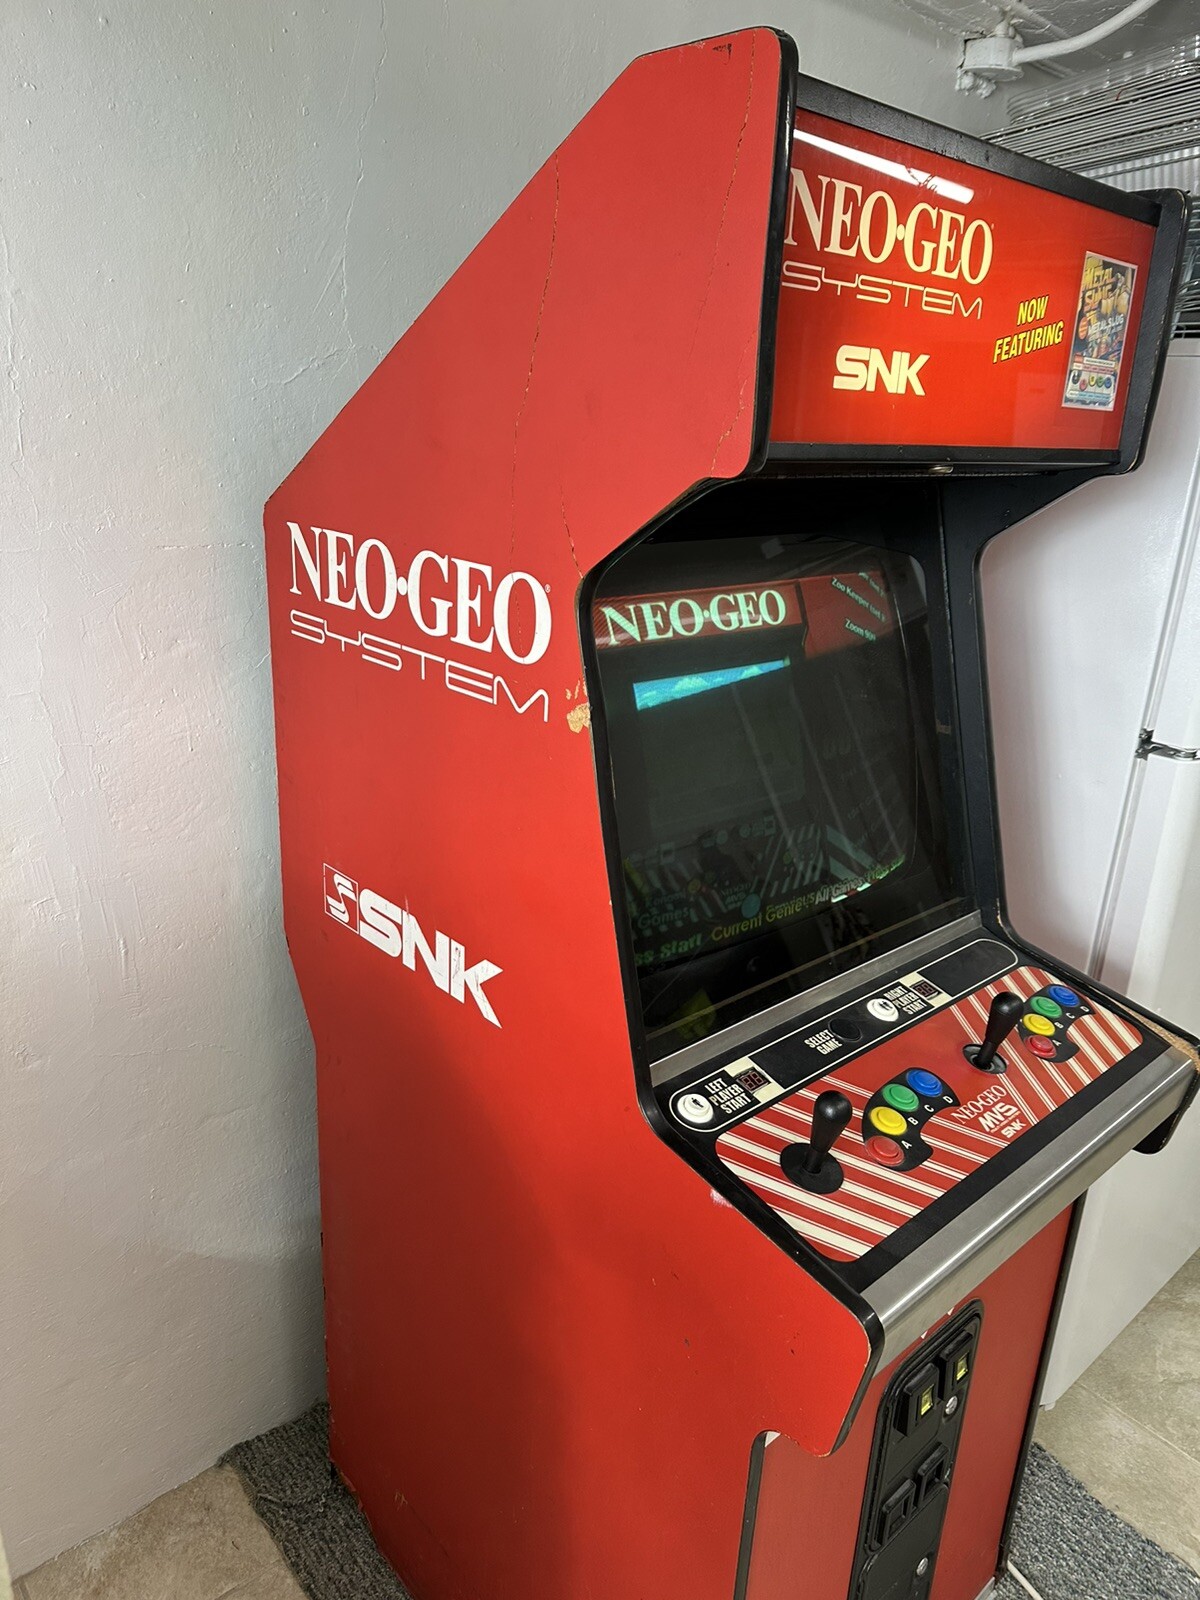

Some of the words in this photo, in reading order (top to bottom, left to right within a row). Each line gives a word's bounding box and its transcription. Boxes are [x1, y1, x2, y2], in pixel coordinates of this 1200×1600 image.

[782, 261, 983, 319] SYSTEM
[1017, 295, 1049, 326] NOW
[993, 320, 1064, 364] FEATURING
[833, 345, 930, 396] SNK
[832, 577, 846, 593] Zoo
[845, 618, 864, 636] Zoom
[290, 609, 548, 722] SYSTEM
[711, 912, 762, 941] Current
[766, 901, 802, 922] Genre
[360, 889, 503, 1028] SNK
[884, 986, 908, 1002] RIGHT
[892, 992, 920, 1008] PLAYER
[902, 999, 927, 1014] START
[804, 1029, 834, 1048] SELECT
[816, 1039, 842, 1054] GAME
[705, 1078, 727, 1093] LEFT
[709, 1084, 744, 1106] PLAYER
[720, 1093, 751, 1113] START
[907, 1117, 918, 1125] B
[978, 1102, 1018, 1132] MVS
[1001, 1119, 1026, 1138] SNK
[901, 1140, 912, 1149] A
